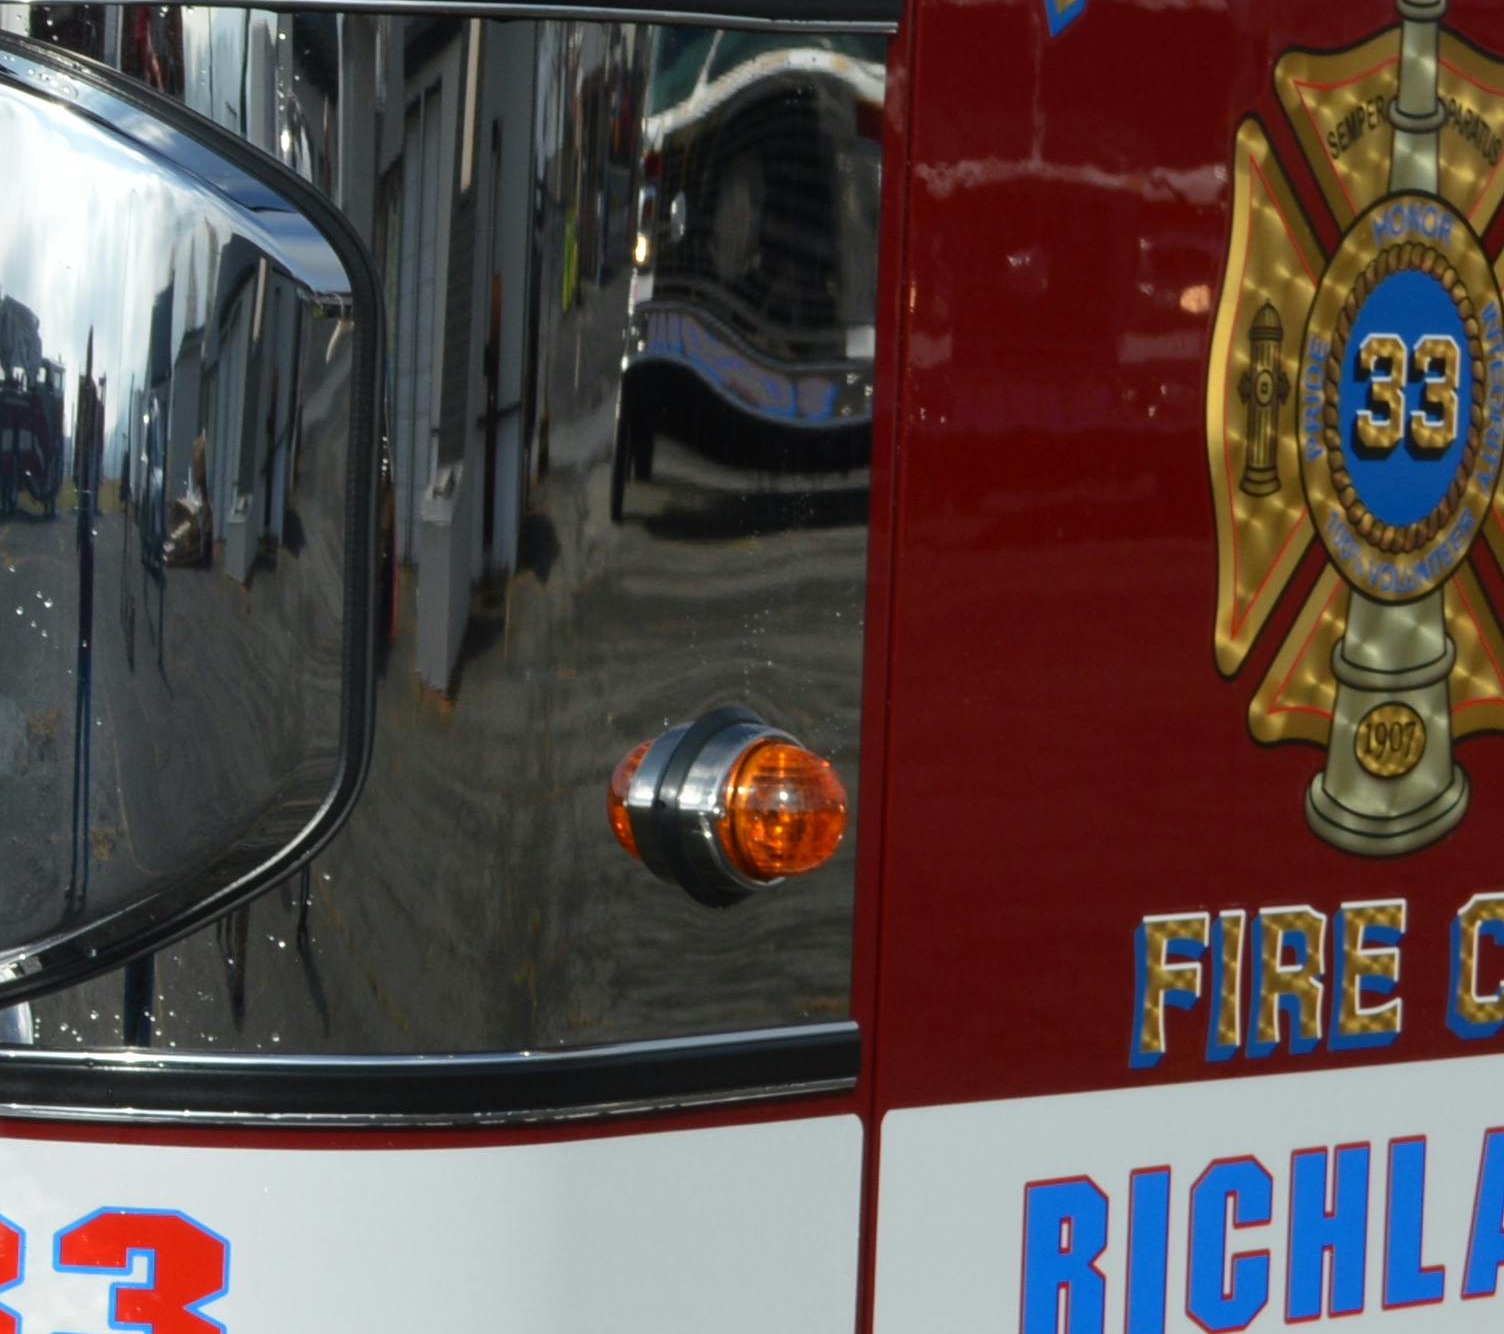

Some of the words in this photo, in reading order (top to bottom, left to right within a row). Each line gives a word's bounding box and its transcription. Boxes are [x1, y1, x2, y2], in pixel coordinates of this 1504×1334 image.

[1327, 95, 1388, 159] SEMPER
[1373, 202, 1455, 247] HONOR
[1353, 333, 1461, 460] 33
[1365, 720, 1417, 760] 1907
[1129, 898, 1407, 1068] FIRE
